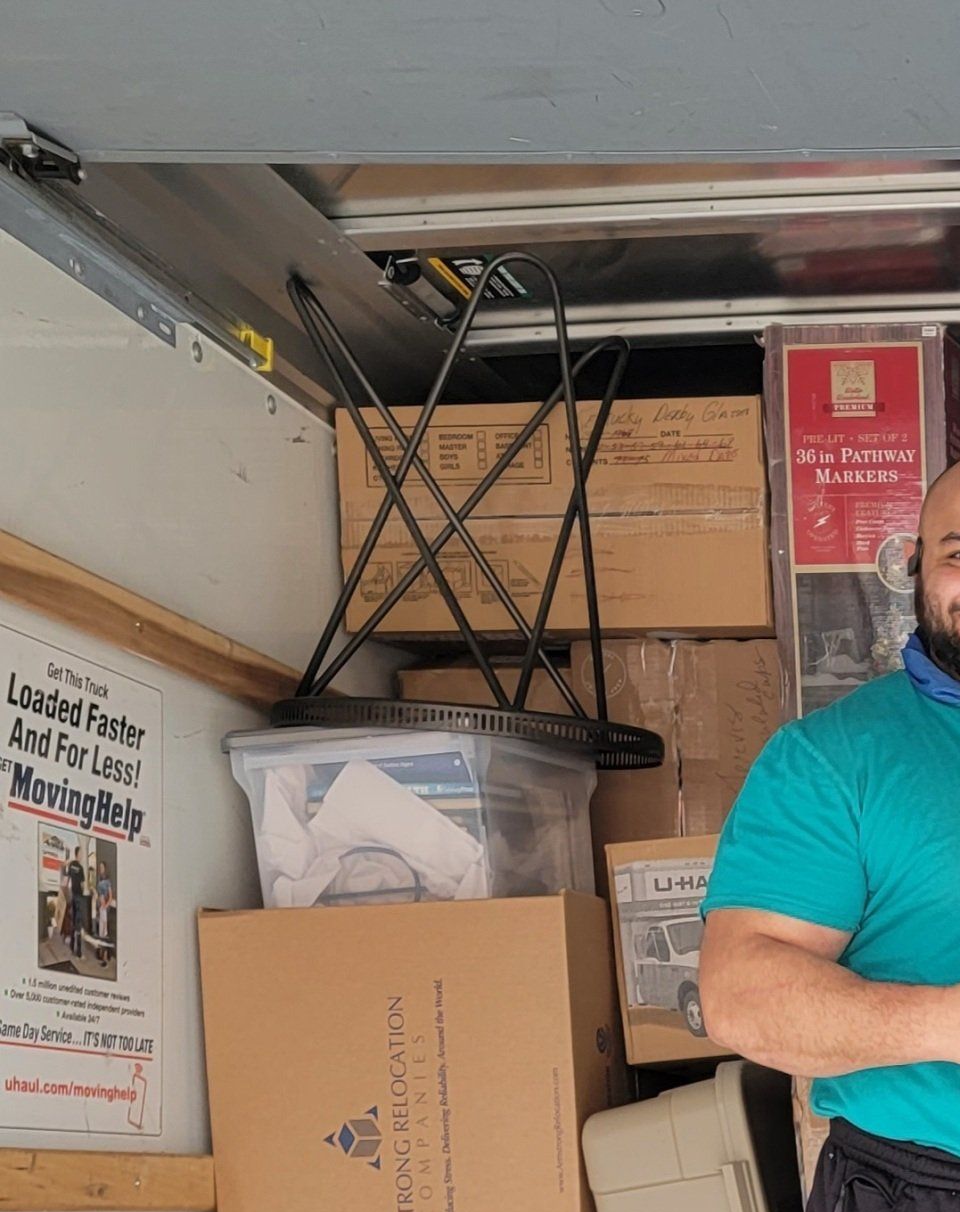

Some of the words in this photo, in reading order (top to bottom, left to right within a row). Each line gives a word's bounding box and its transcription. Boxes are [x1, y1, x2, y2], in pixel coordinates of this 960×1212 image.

[833, 403, 874, 411] PREMIUM
[660, 430, 681, 438] DATE
[803, 434, 846, 444] PRE-LIT
[858, 433, 881, 443] SET
[882, 433, 899, 442] OF
[901, 433, 909, 442] 2
[796, 448, 817, 464] 36
[819, 450, 835, 464] in
[841, 447, 917, 464] PATHWAY
[815, 468, 899, 484] MARKERS
[47, 662, 63, 682] Get
[65, 669, 83, 690] This
[85, 676, 109, 700] Truck
[7, 672, 83, 729] Loaded
[86, 702, 146, 751] Faster
[8, 717, 52, 759] And
[55, 732, 89, 771] For
[91, 744, 142, 789] Less!
[9, 762, 143, 842] MovingHelp
[10, 989, 24, 999] Over
[87, 1002, 120, 1015] independent
[121, 1006, 145, 1017] providers
[433, 978, 443, 1008] World.
[435, 1010, 444, 1024] the
[23, 1023, 40, 1043] Day
[83, 1031, 100, 1047] IT'S
[100, 1033, 118, 1050] NOT
[119, 1035, 134, 1052] TOO
[135, 1038, 154, 1054] LATE
[435, 1025, 446, 1059] Around
[388, 995, 409, 1133] RELOCATION
[5, 1074, 137, 1103] uhaul.com/movinghelp
[437, 1063, 449, 1106] Reliability.
[440, 1108, 451, 1154] Delivering
[443, 1157, 452, 1184] Stress.
